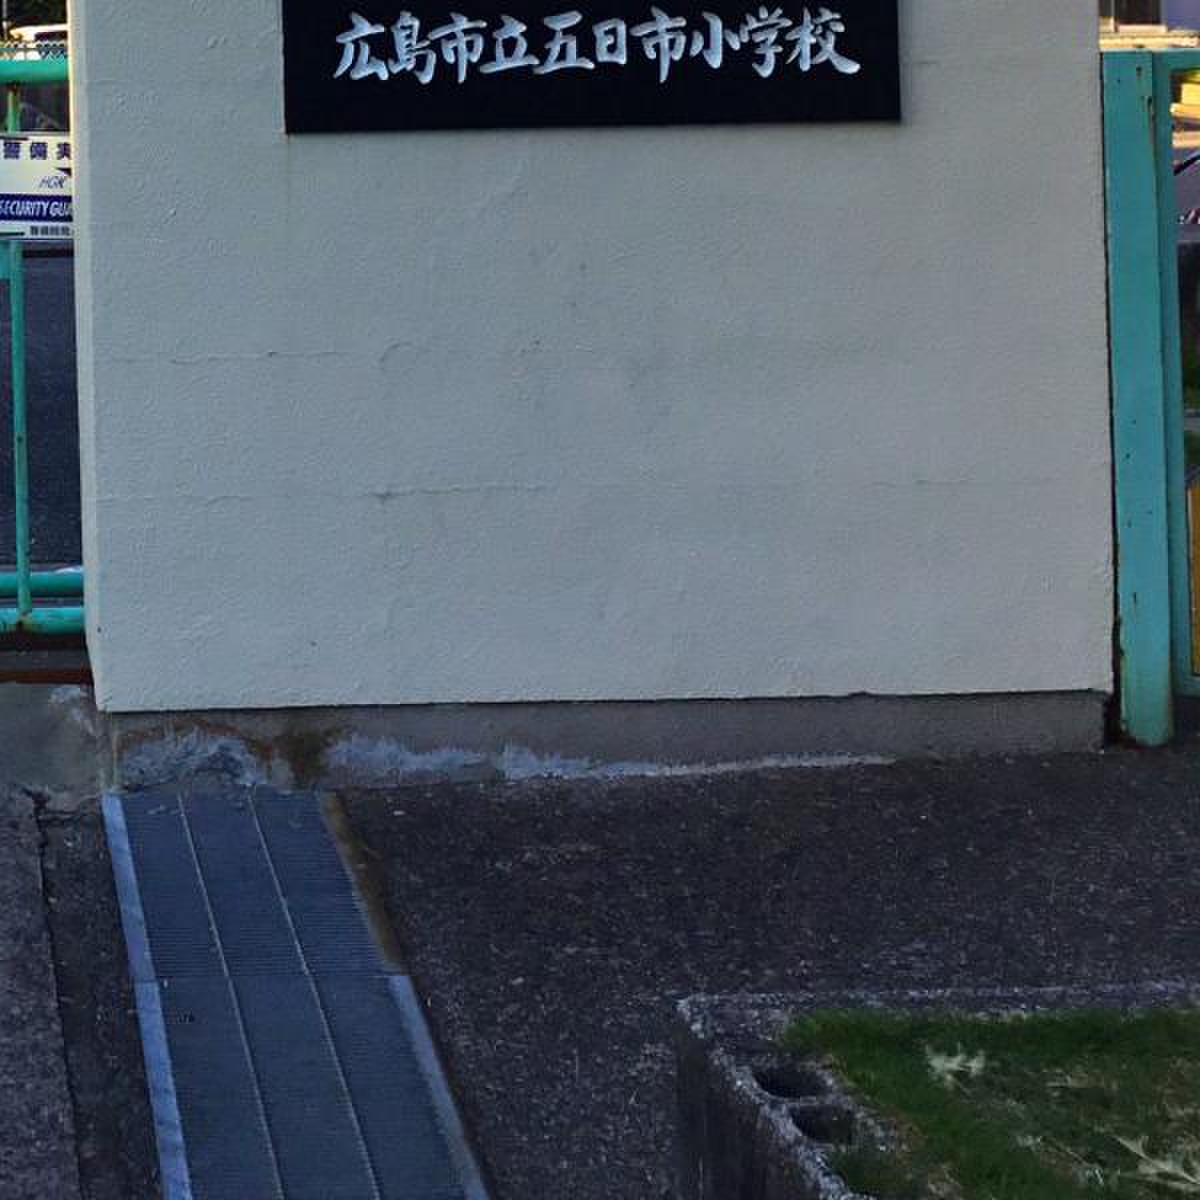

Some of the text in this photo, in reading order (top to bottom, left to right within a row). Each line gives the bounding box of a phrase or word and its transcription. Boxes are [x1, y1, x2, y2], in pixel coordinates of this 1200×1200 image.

[333, 6, 860, 84] 広島市立五日市小学校
